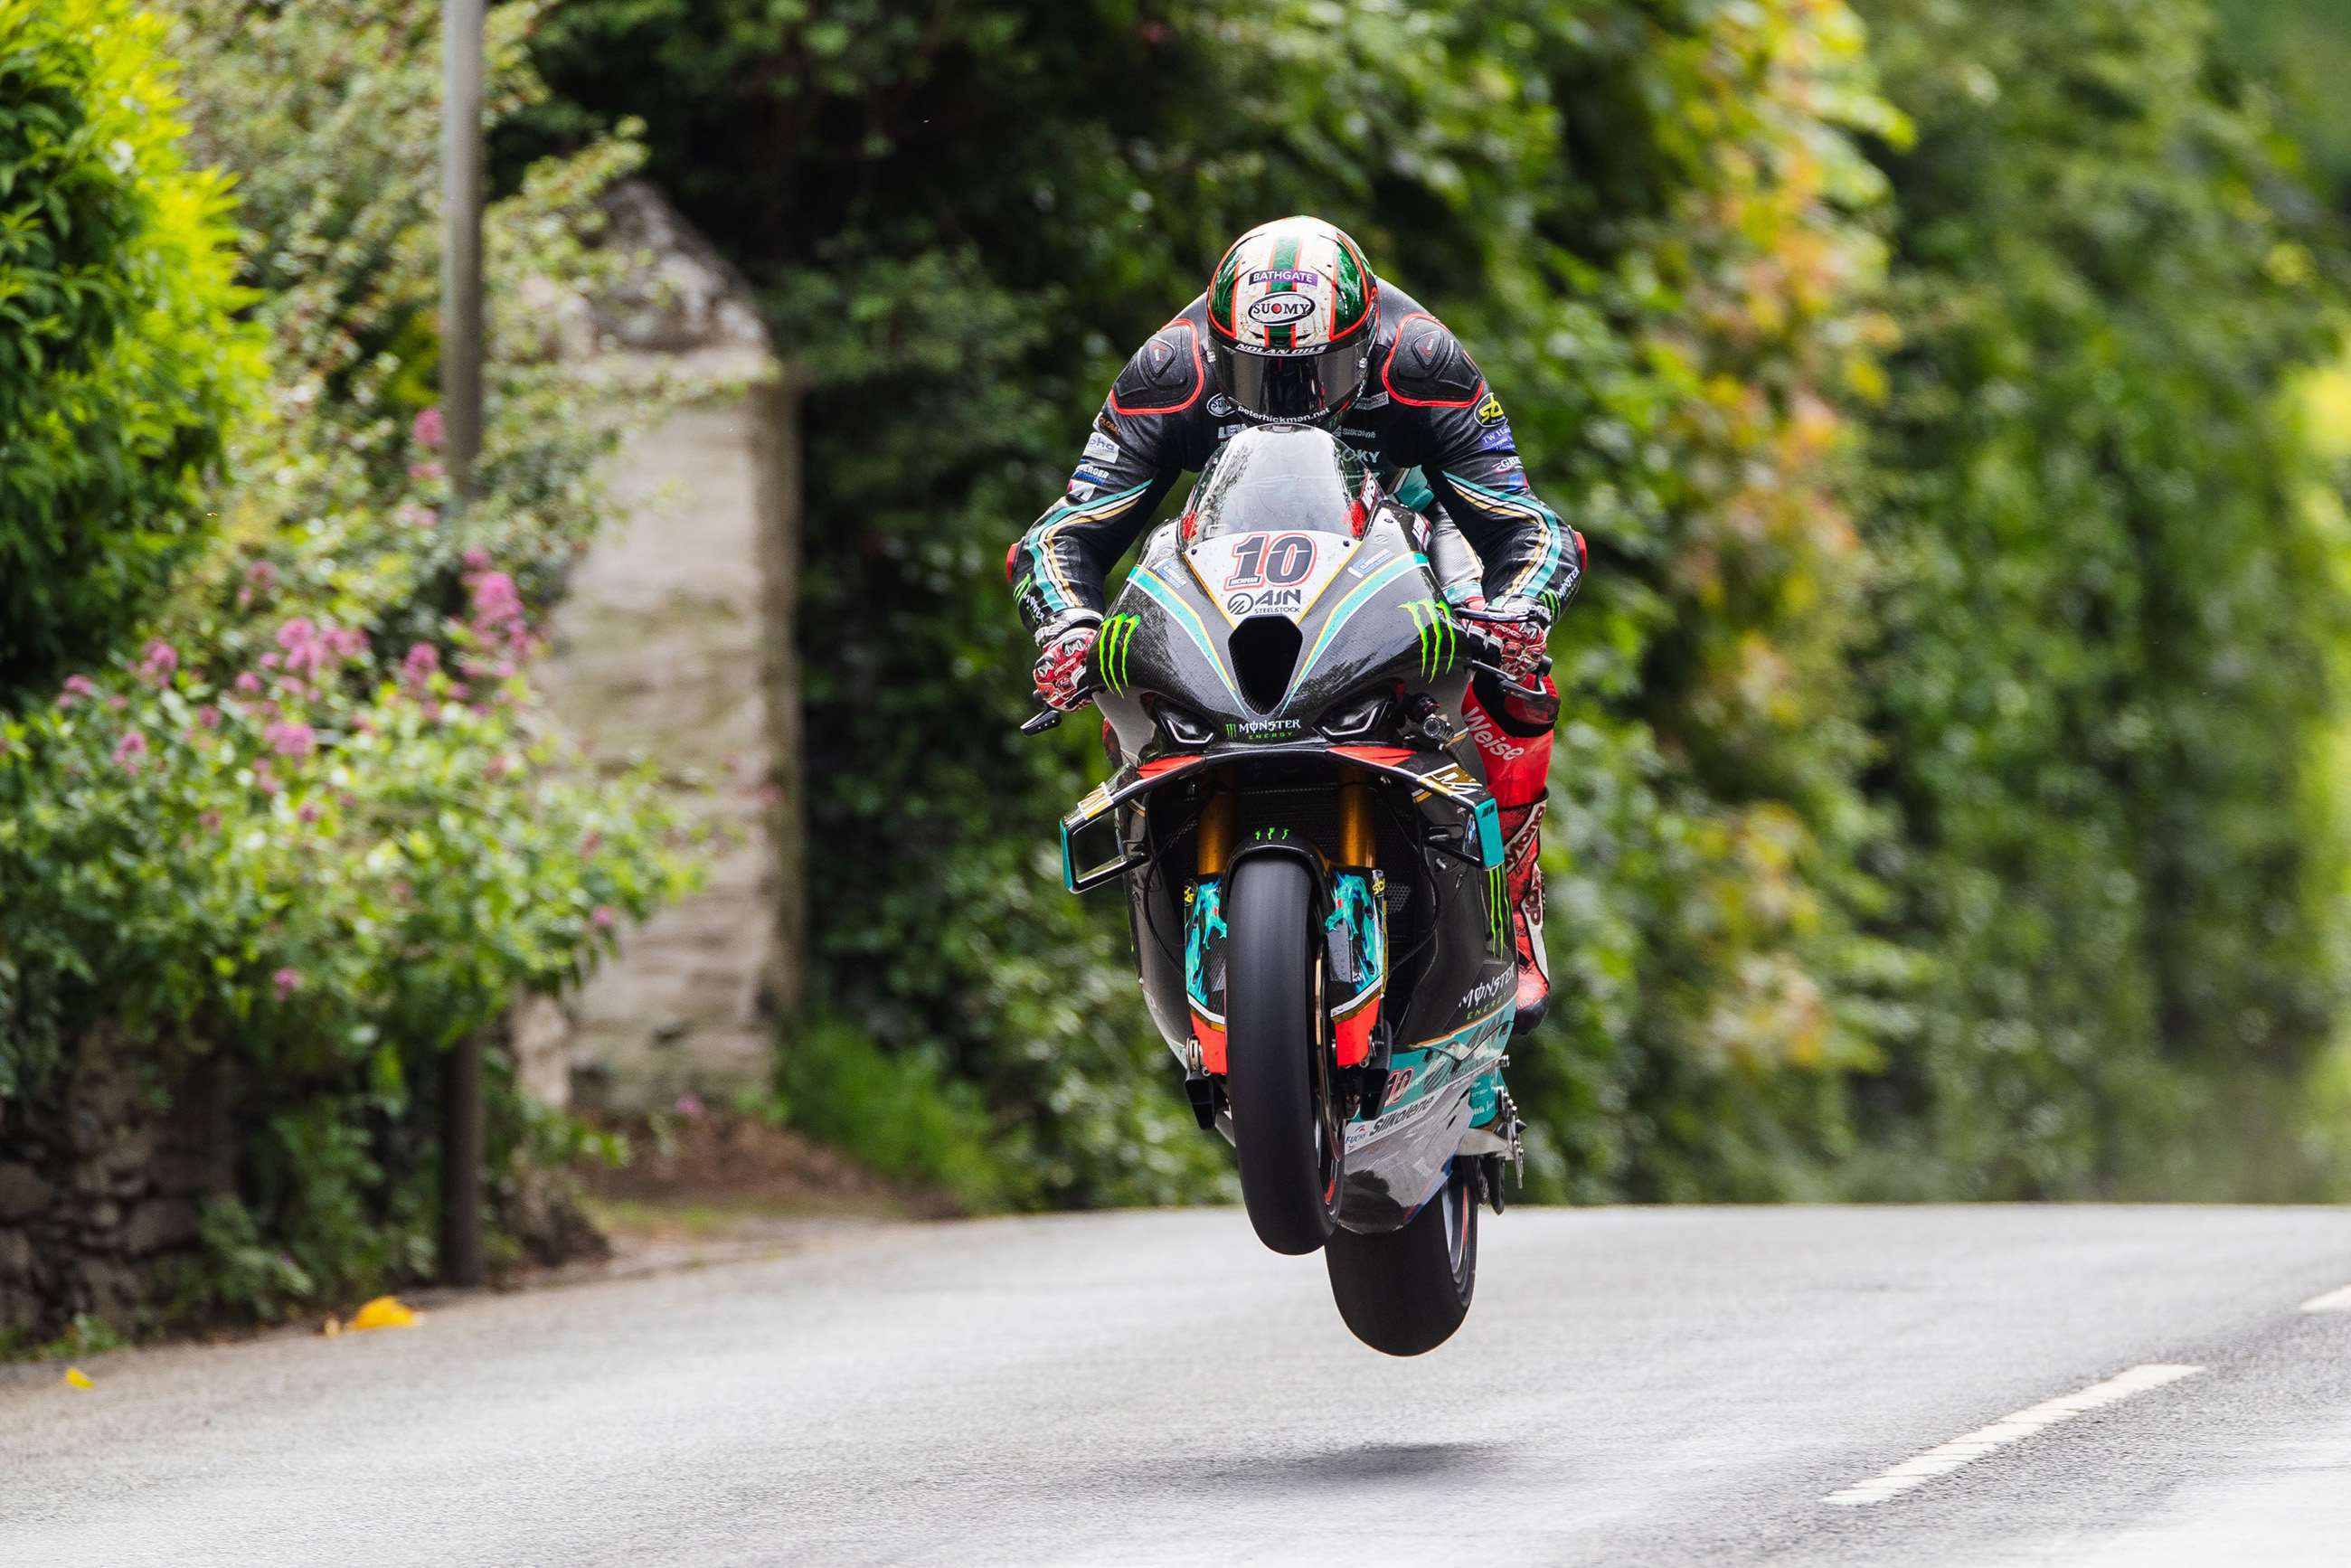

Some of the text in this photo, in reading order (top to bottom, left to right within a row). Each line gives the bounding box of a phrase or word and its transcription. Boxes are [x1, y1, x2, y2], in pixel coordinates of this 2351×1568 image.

[1252, 270, 1314, 283] BATHGATE
[1253, 302, 1310, 315] SUOMY
[1235, 343, 1328, 355] NOLAN OILS
[1237, 405, 1330, 424] peterhickman.net
[1225, 534, 1317, 590] 10
[1255, 589, 1301, 606] AJN
[1254, 606, 1300, 614] STEELSTOCK
[1239, 719, 1302, 734] MONSTER
[1462, 706, 1525, 760] Weise
[1249, 732, 1293, 740] ENERGY
[1458, 961, 1515, 1008] MONSTER
